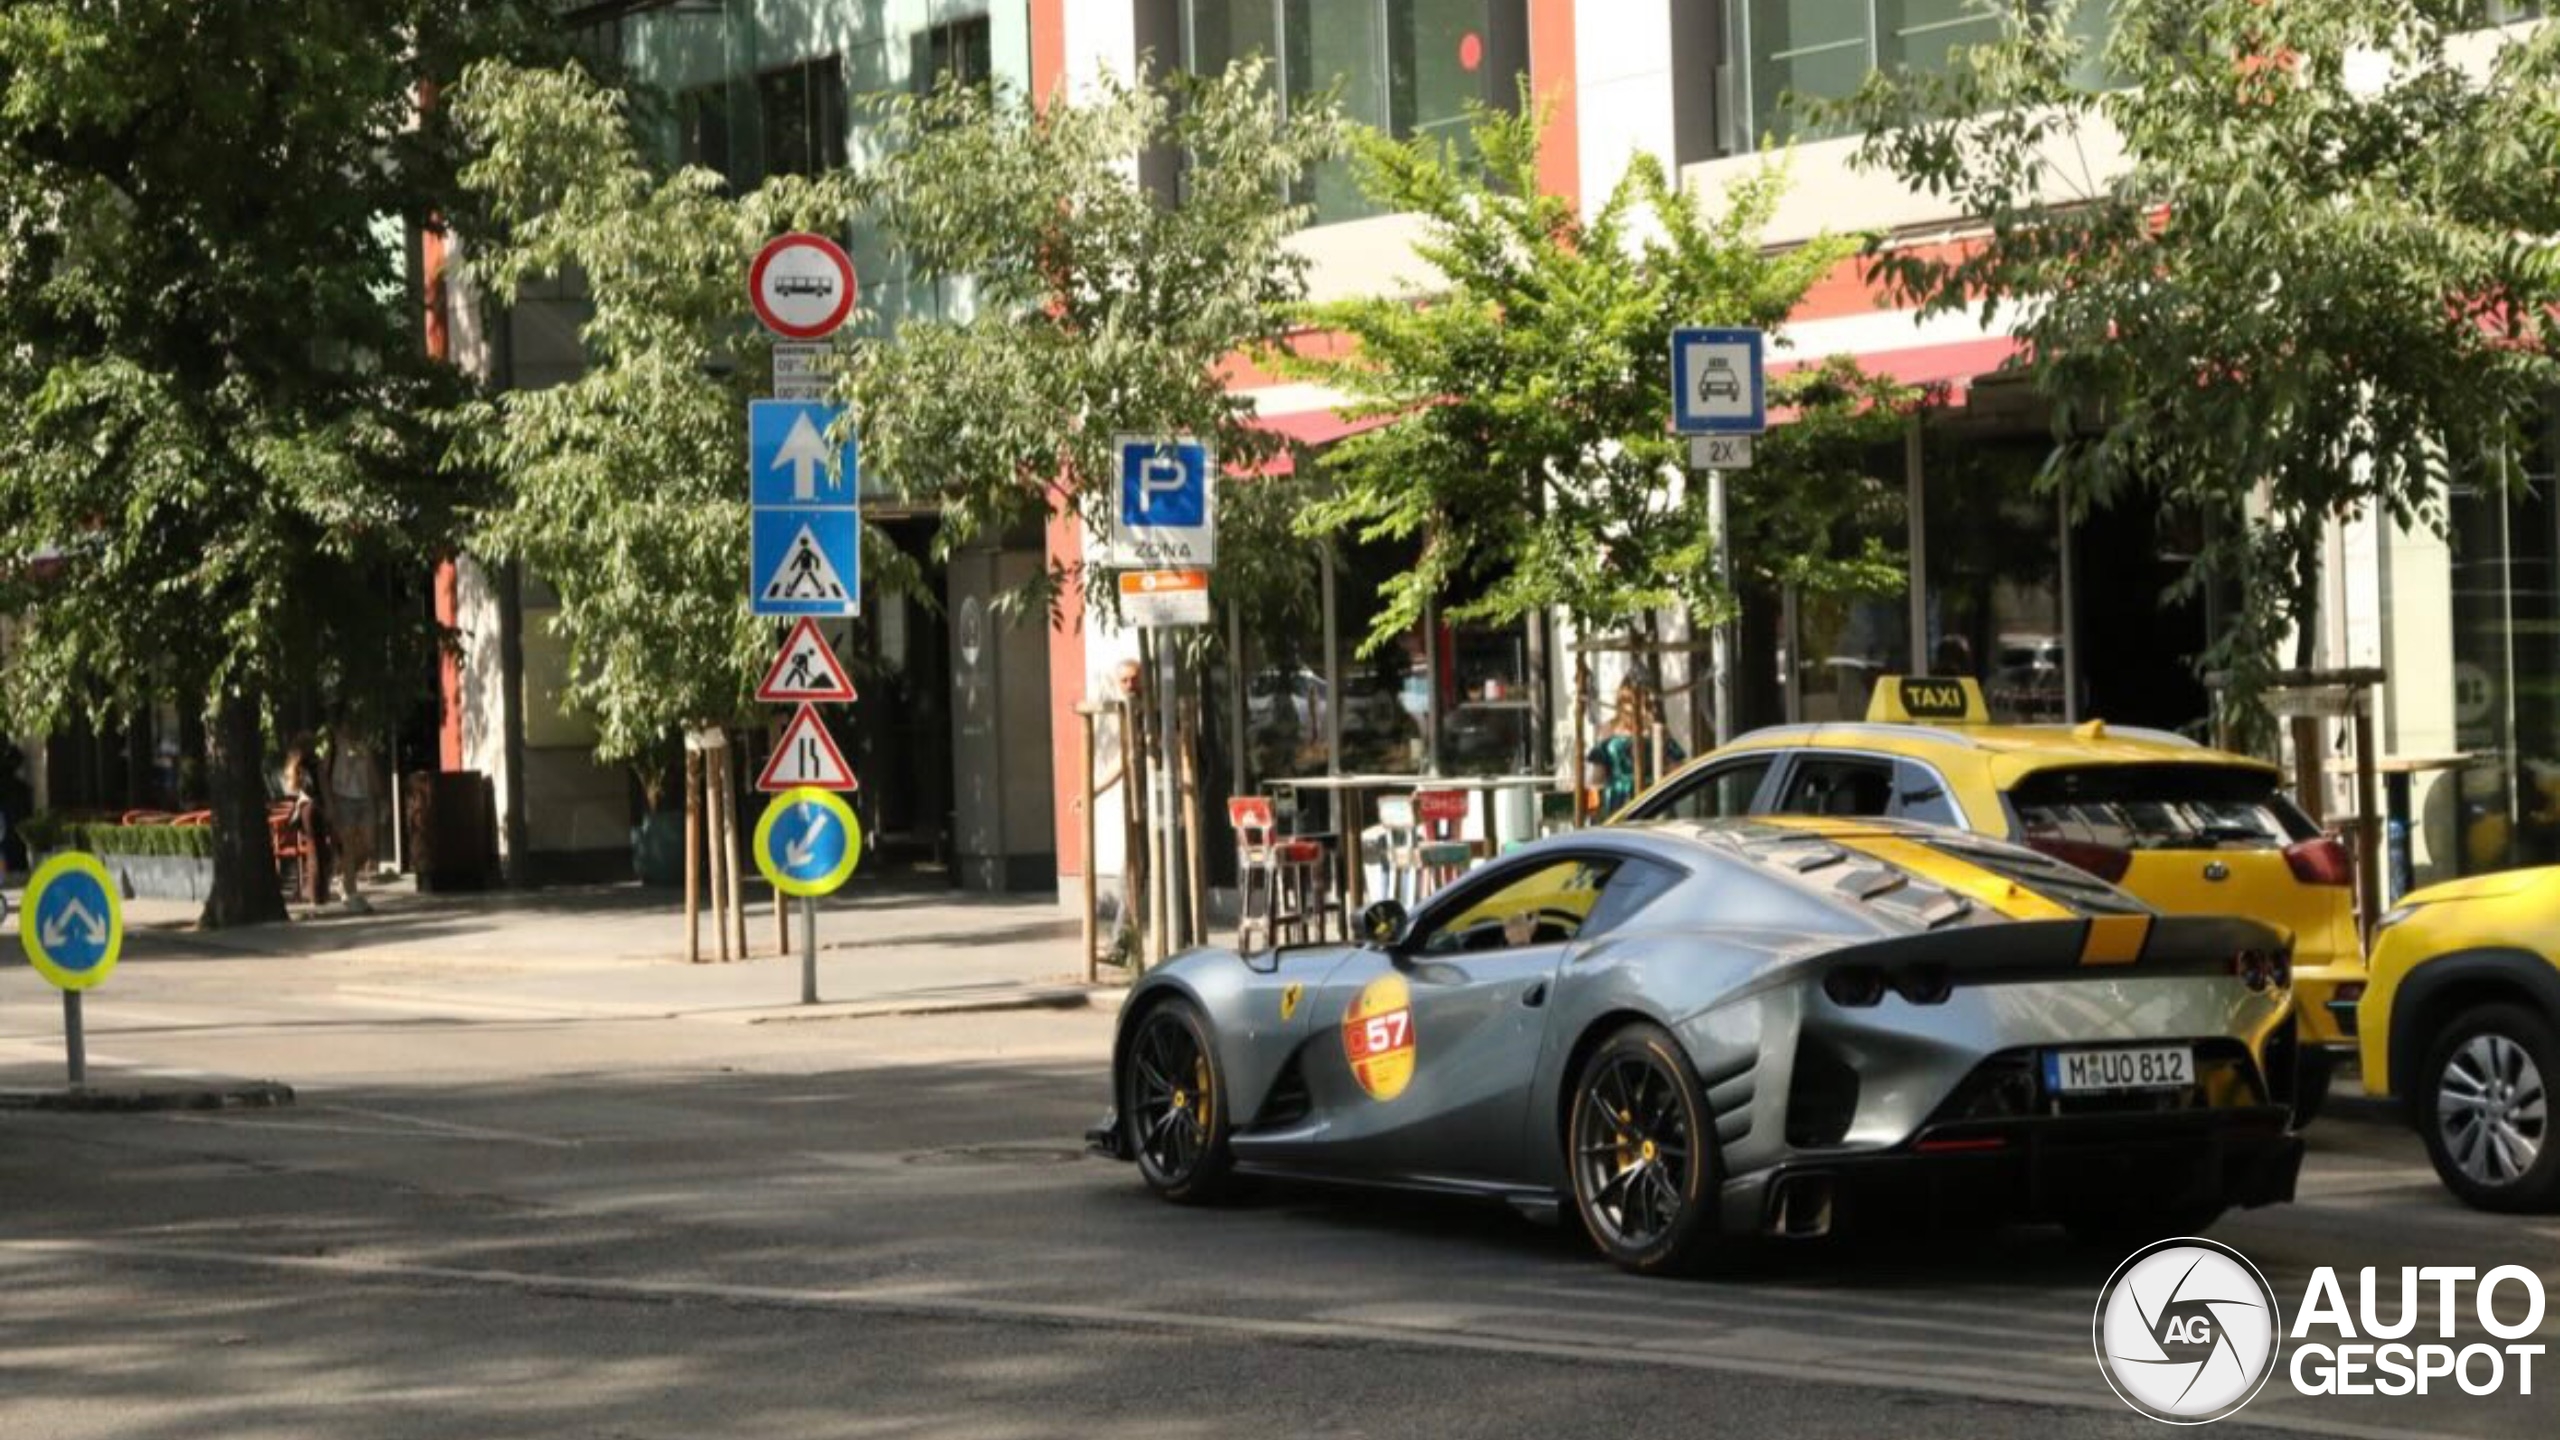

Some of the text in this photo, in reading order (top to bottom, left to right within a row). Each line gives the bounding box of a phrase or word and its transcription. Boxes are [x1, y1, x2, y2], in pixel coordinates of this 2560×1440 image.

[1710, 441, 1734, 462] 2X
[1140, 458, 1187, 512] P
[1135, 541, 1192, 558] ZONA
[1907, 686, 1962, 707] TAXI
[2069, 1056, 2086, 1086] M
[2140, 1051, 2185, 1082] 812
